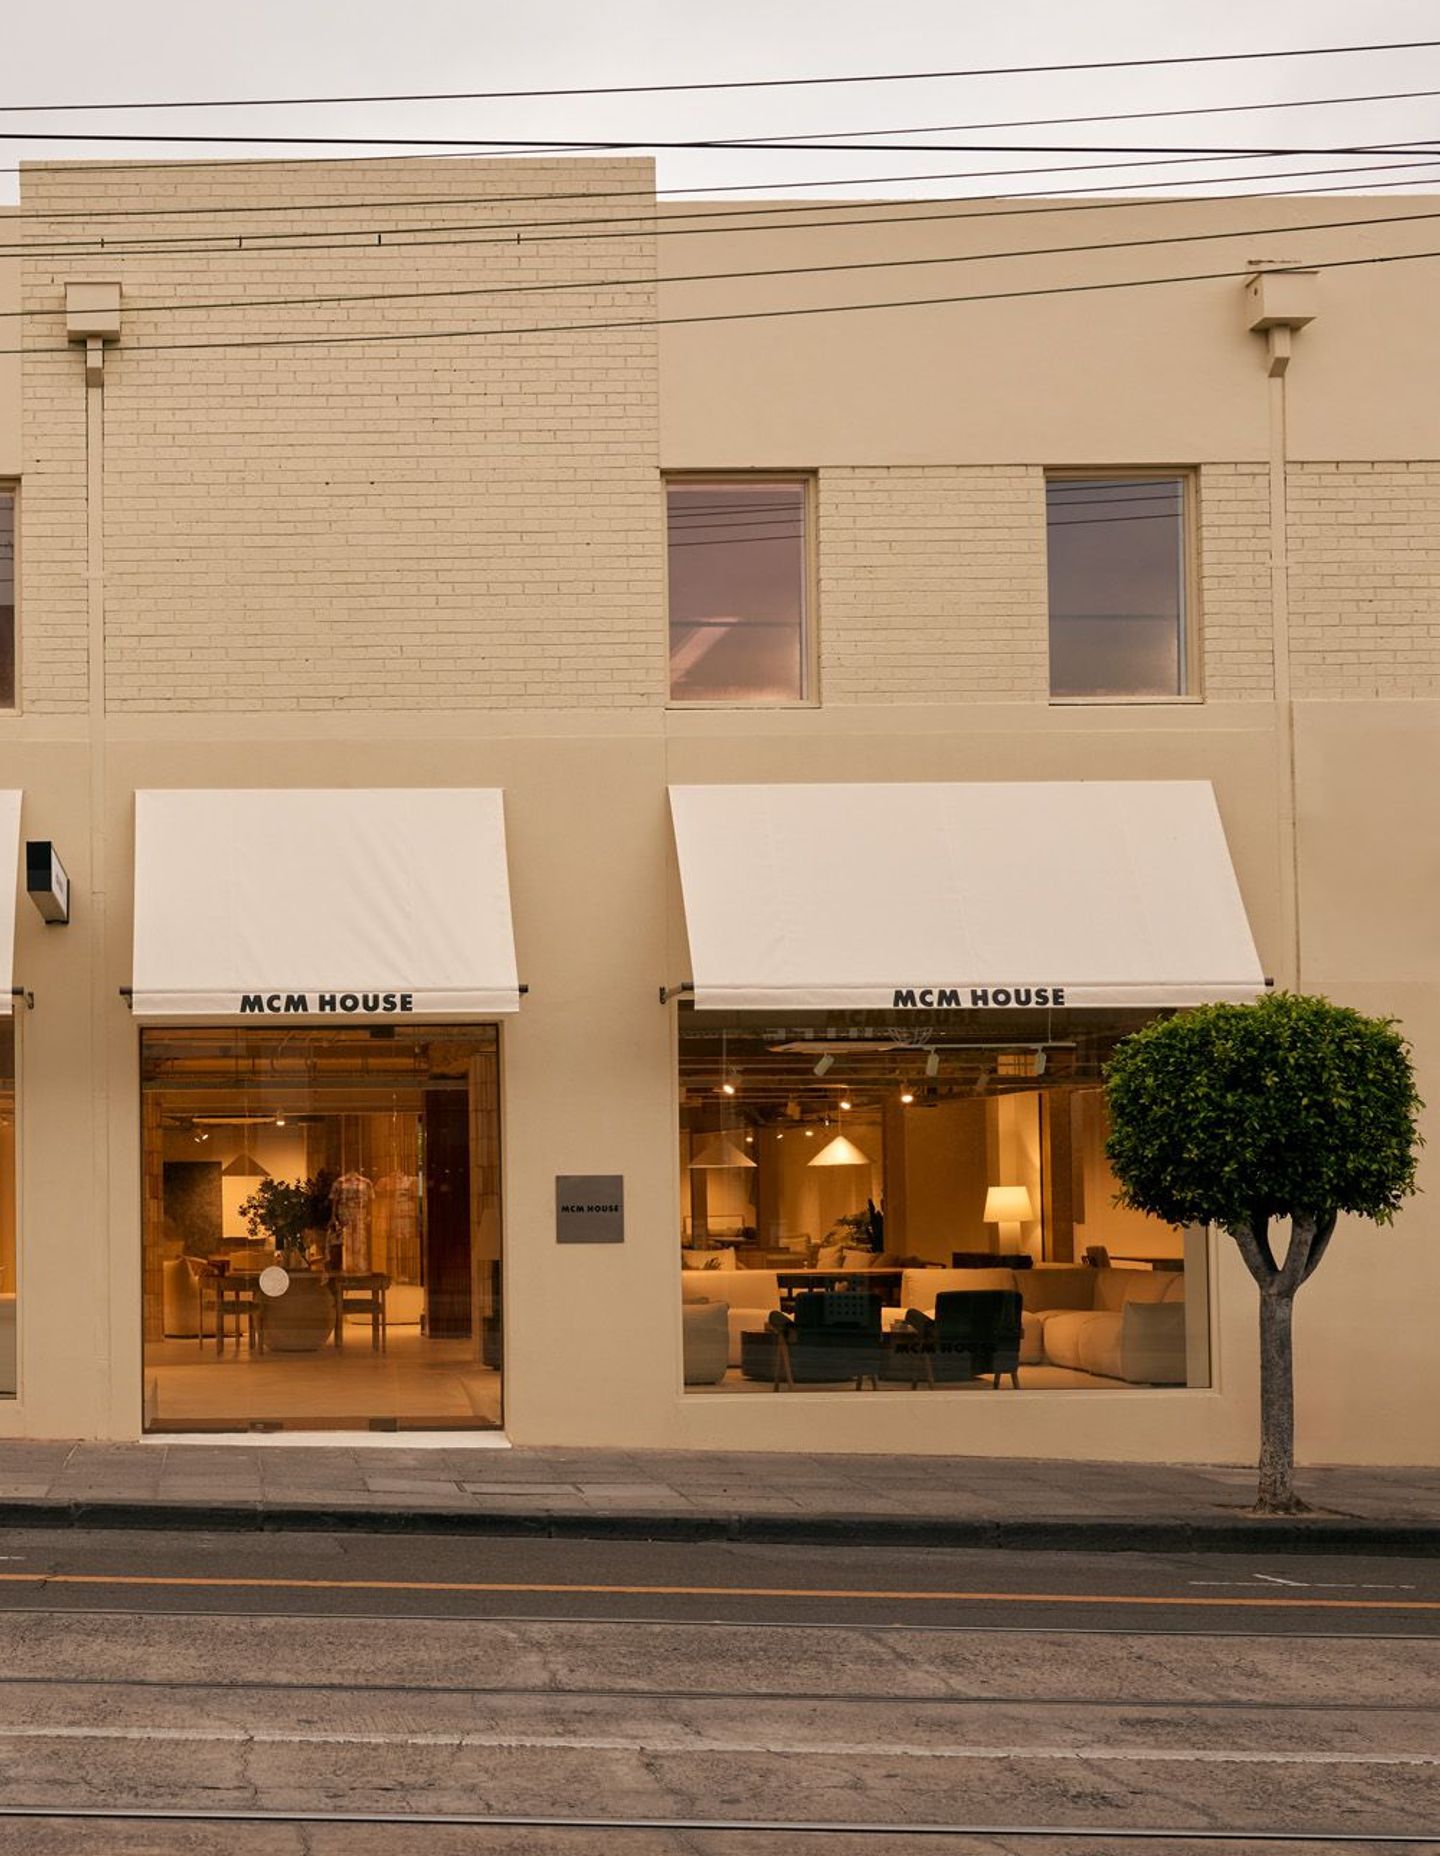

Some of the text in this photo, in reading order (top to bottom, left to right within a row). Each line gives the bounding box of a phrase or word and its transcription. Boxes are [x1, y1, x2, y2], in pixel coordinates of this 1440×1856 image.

[240, 993, 413, 1013] MCM HOUSE
[893, 988, 1065, 1007] MCM HOUSE
[561, 1204, 618, 1213] MCM HOUSE
